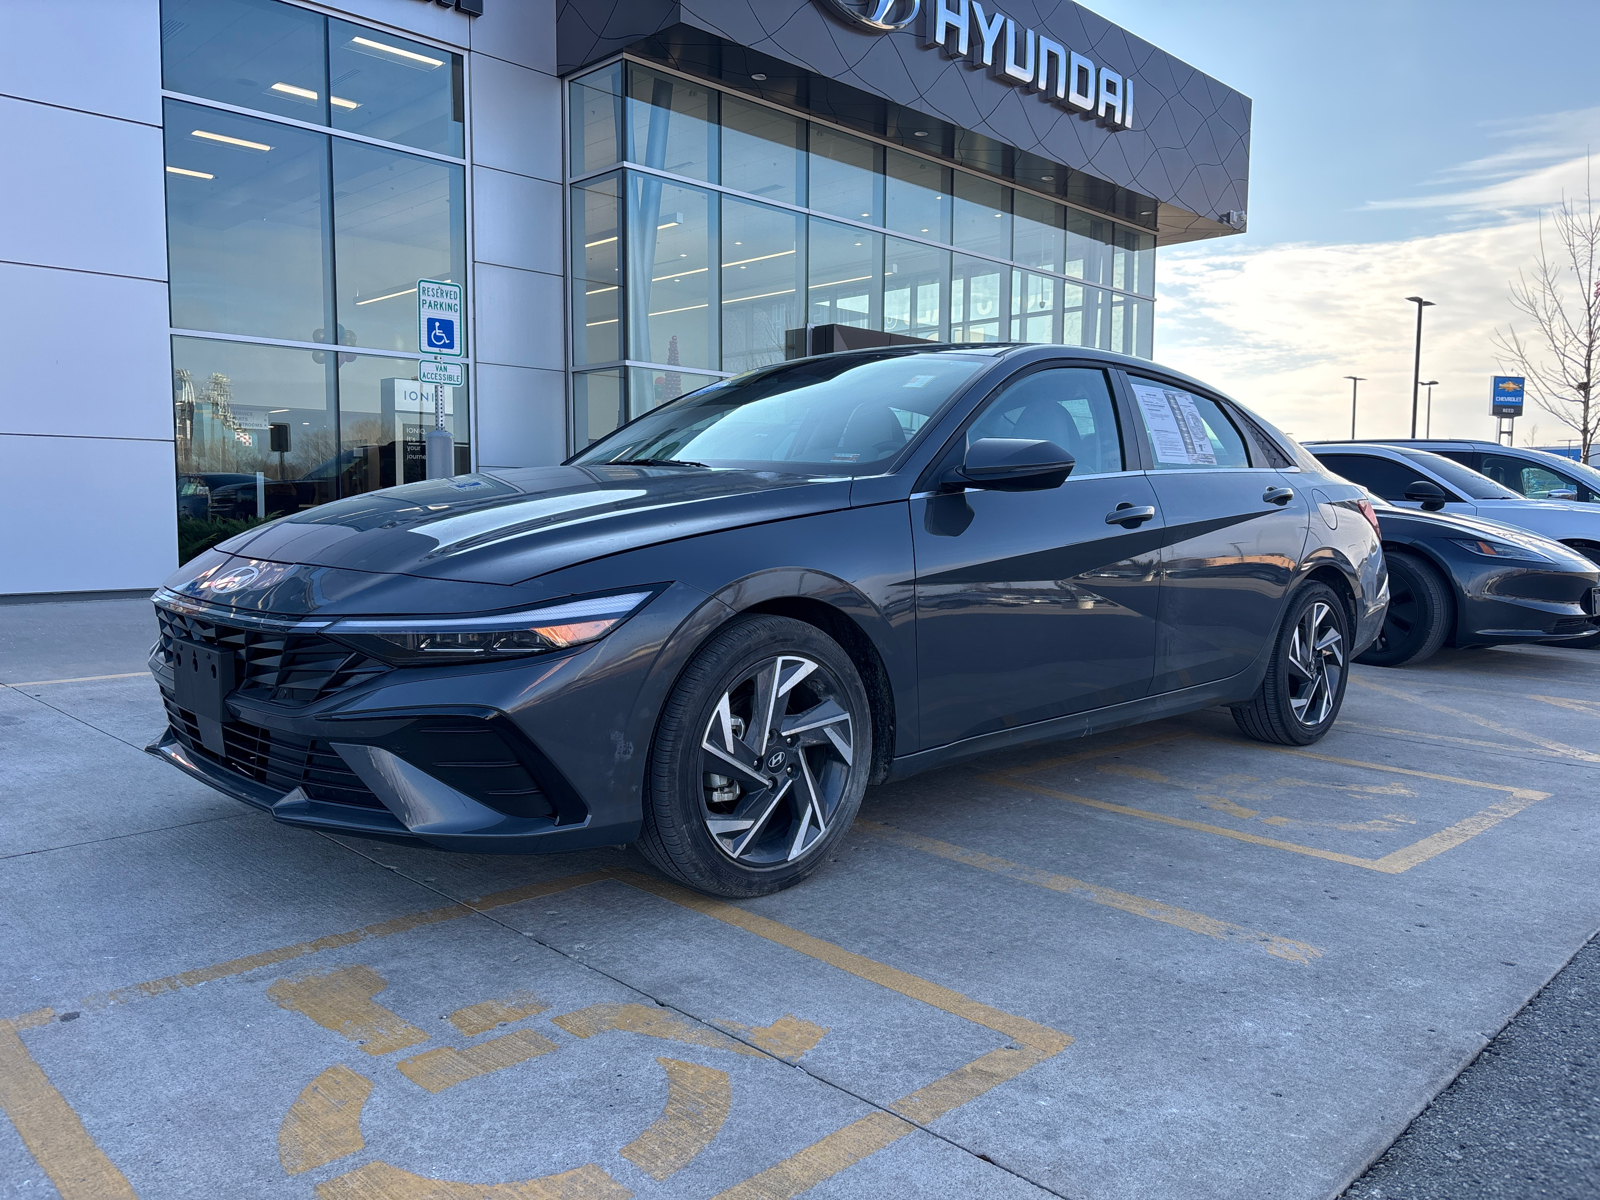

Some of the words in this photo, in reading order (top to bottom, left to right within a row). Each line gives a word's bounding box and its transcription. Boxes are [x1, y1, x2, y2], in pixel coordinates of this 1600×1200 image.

[932, 0, 1134, 131] HYUNDAI
[421, 286, 458, 300] RESERVED
[421, 299, 458, 313] PARKING
[435, 364, 448, 373] VAN
[422, 372, 460, 383] ACCESSIBLE
[404, 390, 434, 402] IONI
